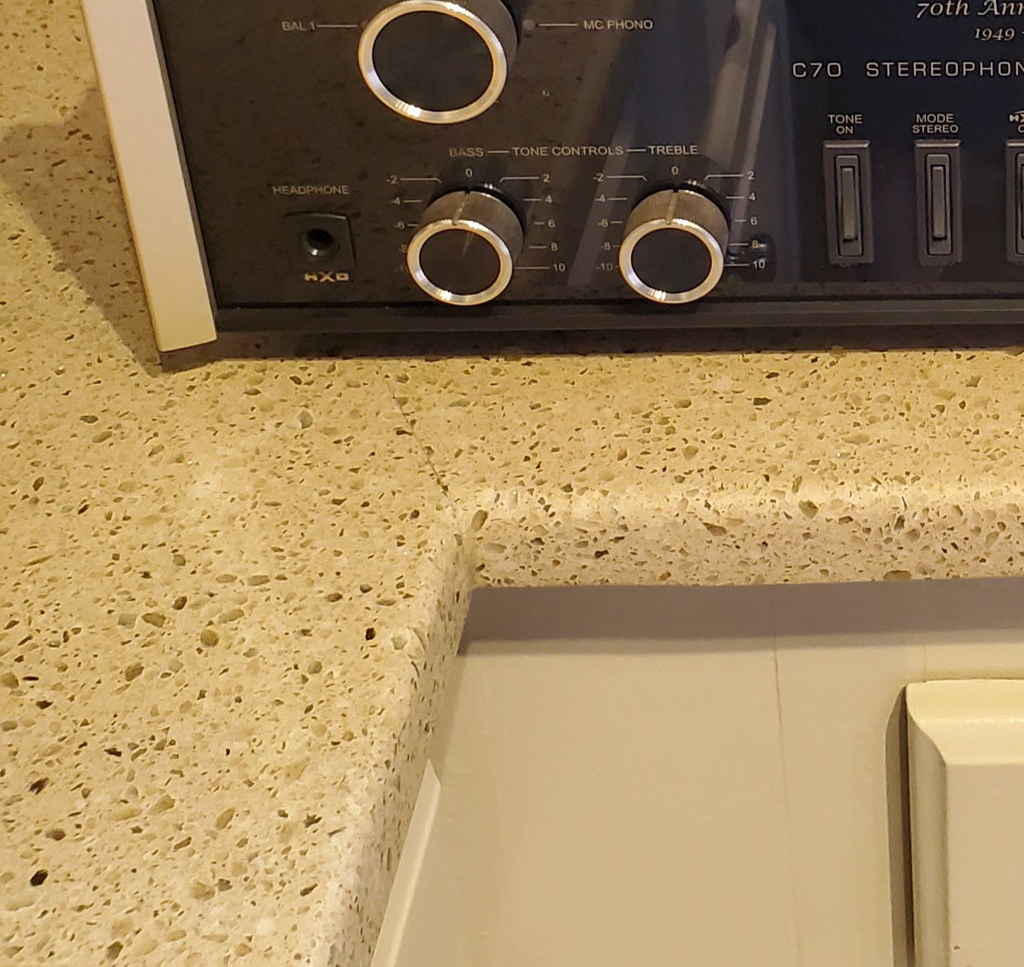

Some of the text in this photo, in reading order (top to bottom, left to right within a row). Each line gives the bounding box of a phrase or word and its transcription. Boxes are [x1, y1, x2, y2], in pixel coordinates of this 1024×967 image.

[281, 21, 316, 31] BAL 1
[583, 20, 654, 30] MC PHONO
[974, 27, 1015, 41] 1949
[792, 62, 842, 78] C70
[827, 114, 863, 124] TONE
[916, 114, 954, 123] MODE
[836, 125, 854, 135] ON
[912, 124, 959, 134] STEREO
[449, 145, 699, 157] BASS TONE CONTROLS TREBLE
[465, 168, 473, 177] 0
[671, 166, 679, 175] 0
[386, 175, 398, 184] -2
[543, 173, 550, 183] 2
[593, 173, 604, 182] -2
[747, 171, 755, 180] 2
[272, 185, 350, 195] HEADPHONE
[391, 196, 401, 205] -4
[545, 195, 552, 204] 4
[595, 195, 606, 203] -4
[748, 192, 756, 201] 4
[548, 219, 556, 228] 6
[598, 218, 608, 227] -6
[751, 216, 758, 226] 6
[551, 243, 559, 251] 8
[600, 242, 611, 250] -8
[752, 240, 759, 249] 8
[553, 263, 566, 272] 10
[597, 262, 613, 271] -10
[753, 259, 766, 269] 10
